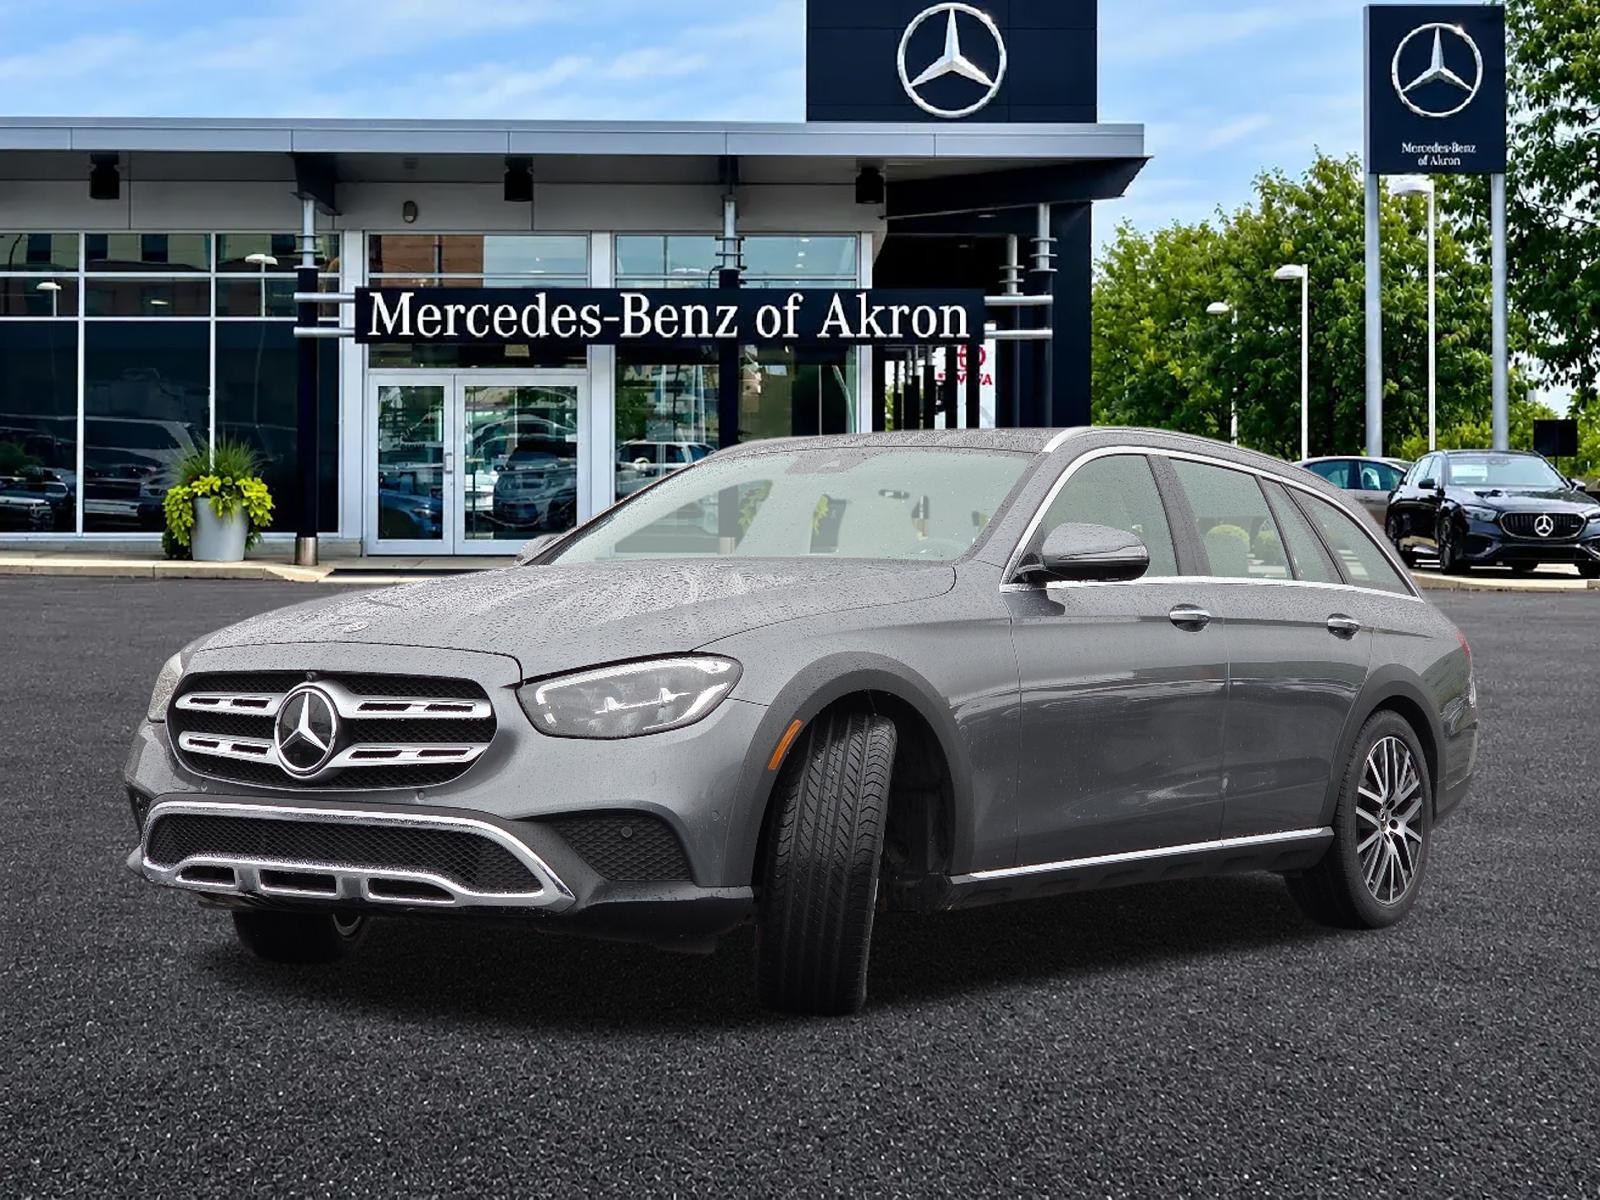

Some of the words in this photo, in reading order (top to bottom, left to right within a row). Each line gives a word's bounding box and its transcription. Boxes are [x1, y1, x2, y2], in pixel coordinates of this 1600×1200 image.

[1401, 141, 1477, 154] Mercedes-Benz
[1417, 154, 1428, 166] of
[1429, 154, 1461, 166] Akron
[367, 291, 738, 338] Mercedes-Benz
[755, 292, 804, 338] of
[816, 292, 970, 338] Akron
